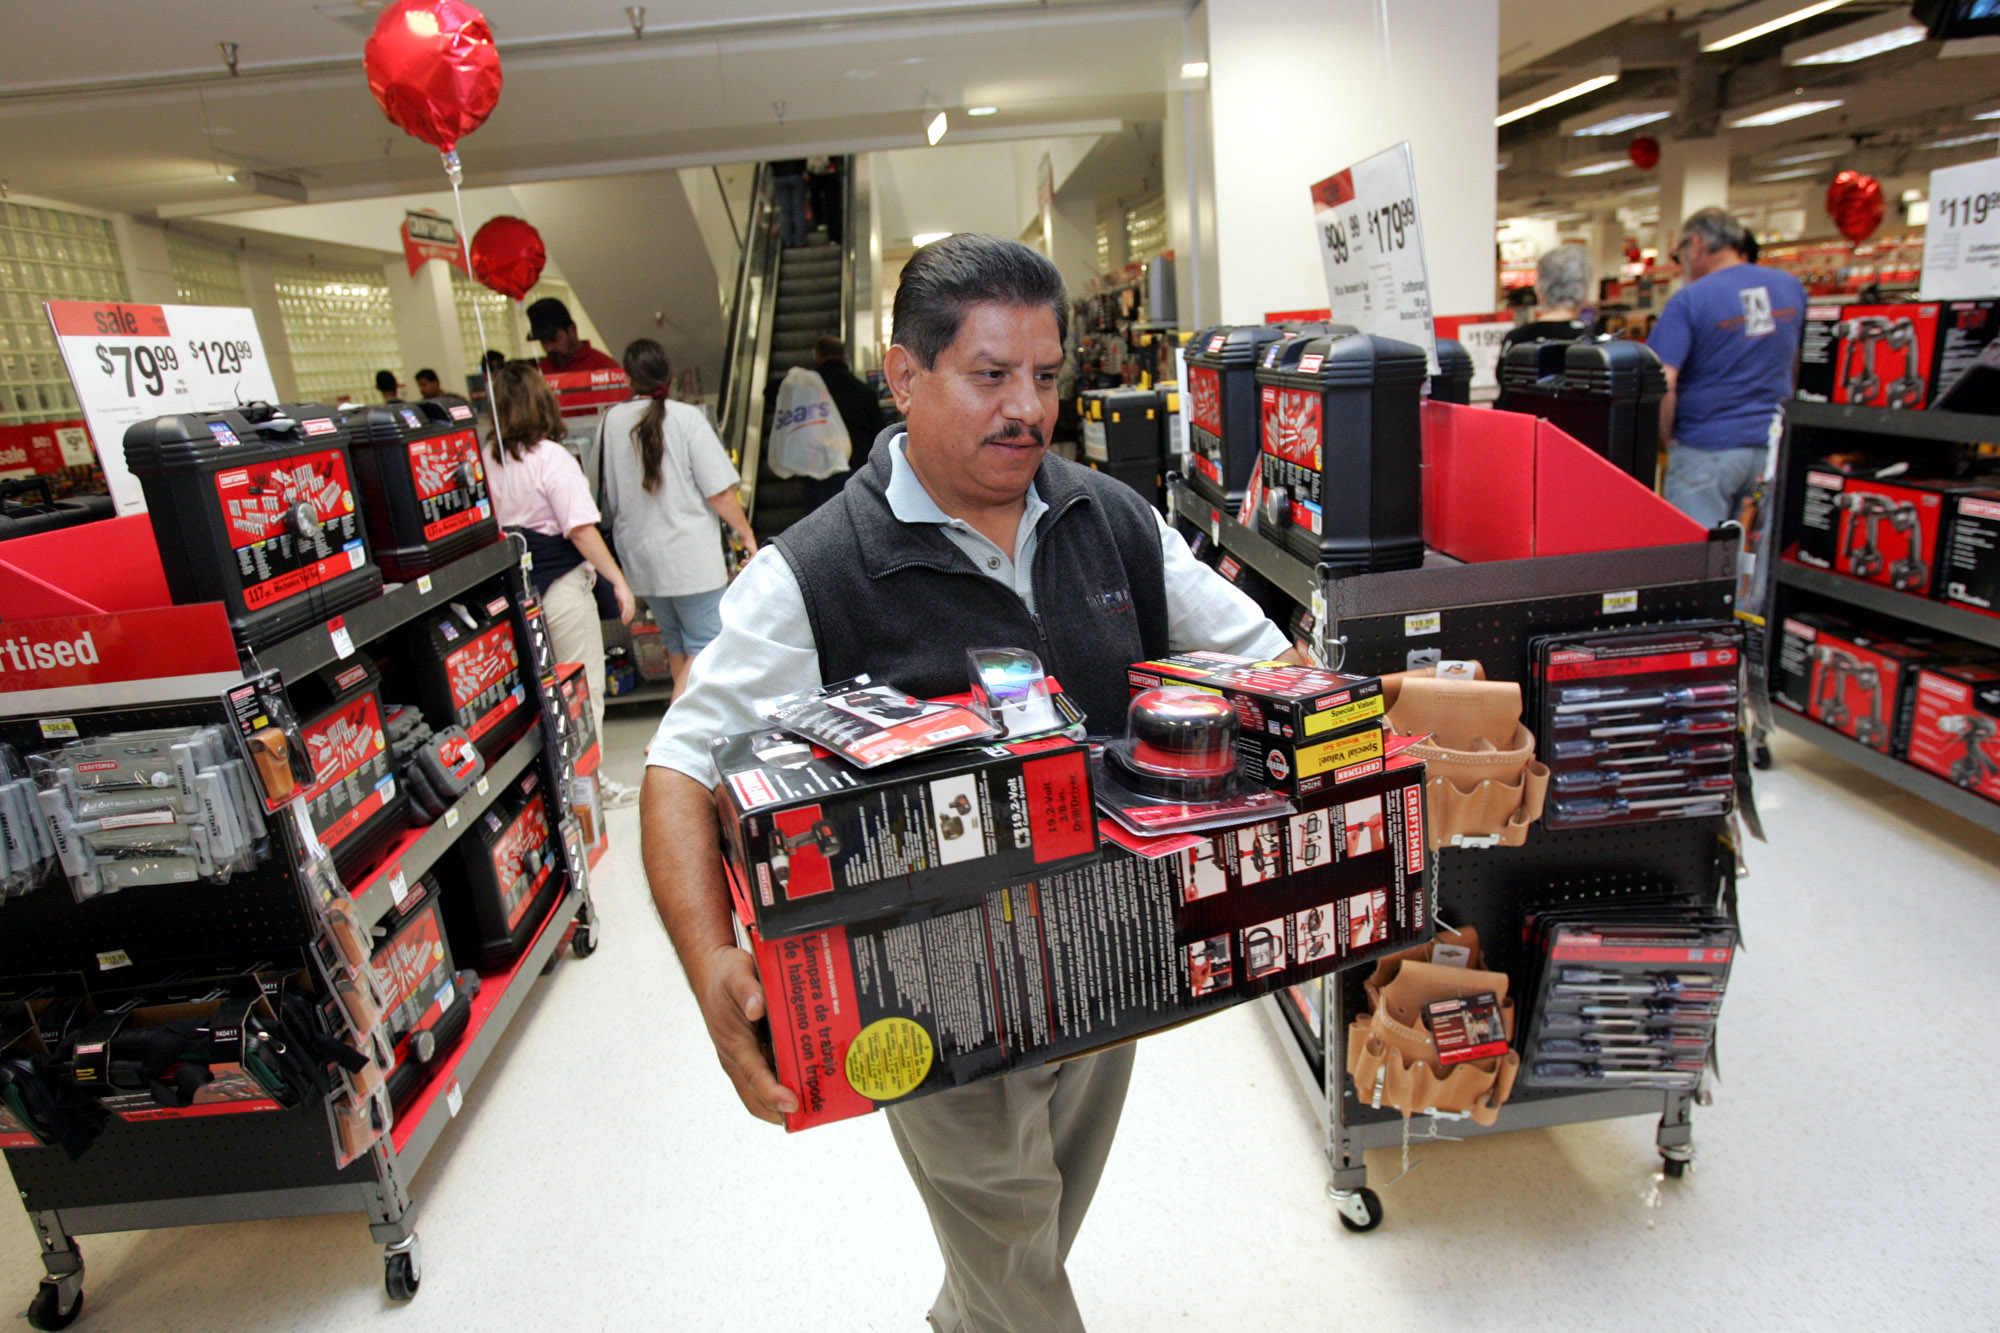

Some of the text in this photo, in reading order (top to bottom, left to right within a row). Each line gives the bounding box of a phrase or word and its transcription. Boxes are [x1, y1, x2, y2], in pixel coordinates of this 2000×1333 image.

[94, 306, 138, 334] sale
[776, 402, 829, 430] Sears
[1331, 698, 1377, 718] Special Value!
[1319, 742, 1378, 766] Special Value!
[1337, 760, 1380, 780] CRAFTSMAN
[1007, 777, 1022, 828] 19.2-Volt
[1043, 781, 1057, 833] 19.2-Volt
[1068, 775, 1081, 833] Drill/Driver
[1406, 788, 1420, 868] CRAFTSMAN
[784, 941, 823, 1112] de halógeno con trípode
[802, 935, 835, 1076] Lámpara de trabajo
